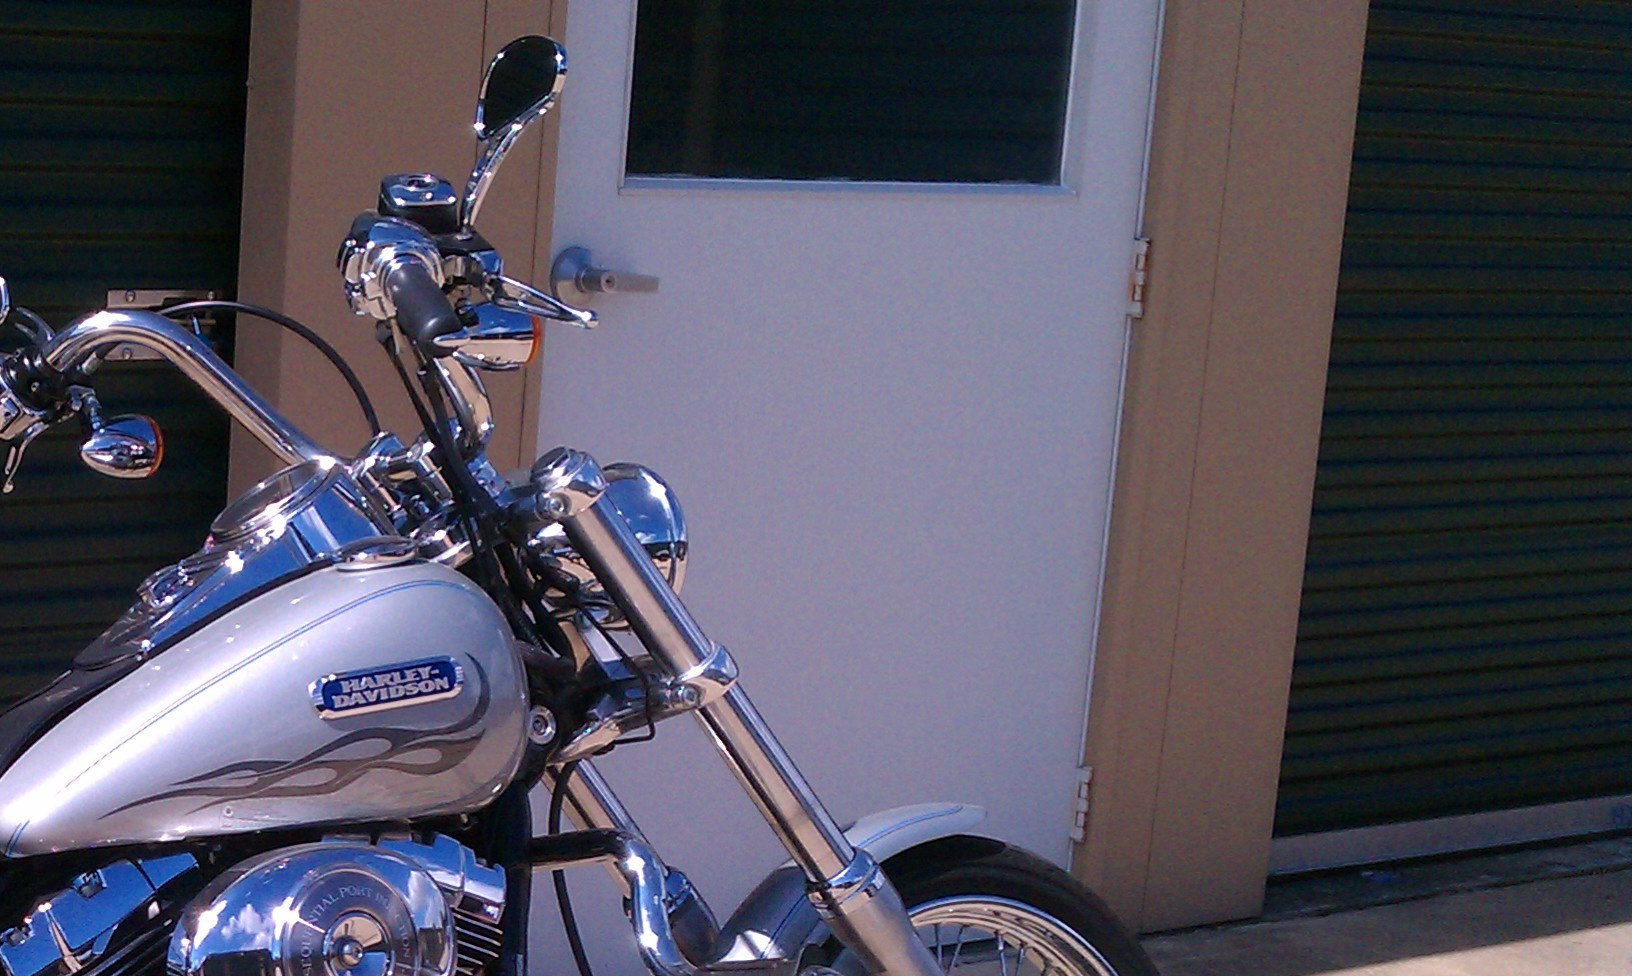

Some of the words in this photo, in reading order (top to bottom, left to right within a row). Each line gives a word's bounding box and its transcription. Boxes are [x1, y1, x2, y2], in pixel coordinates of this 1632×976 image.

[331, 676, 450, 709] DAVIDSON
[340, 665, 440, 694] HARLEY-
[339, 885, 371, 898] PORT
